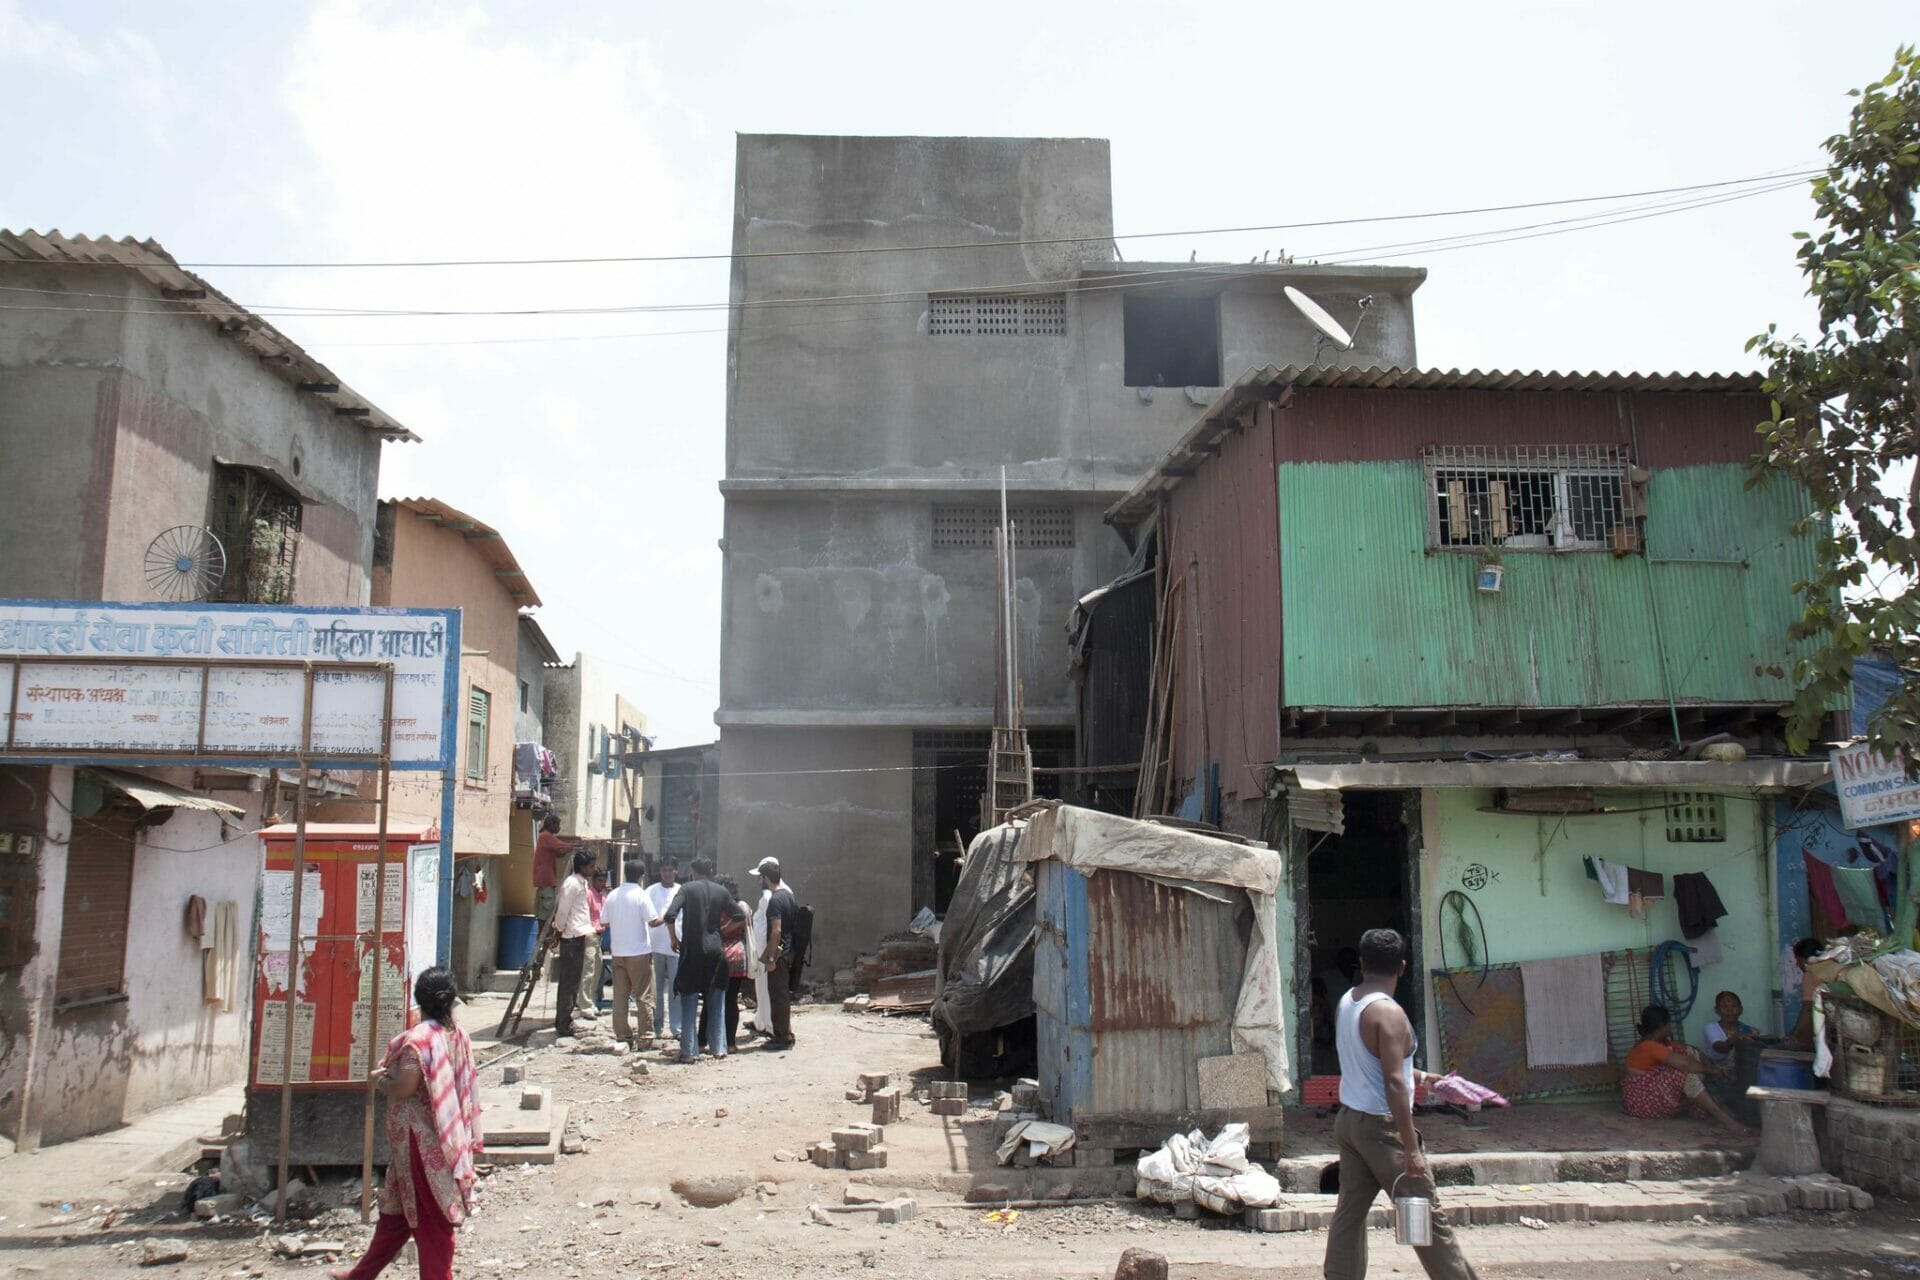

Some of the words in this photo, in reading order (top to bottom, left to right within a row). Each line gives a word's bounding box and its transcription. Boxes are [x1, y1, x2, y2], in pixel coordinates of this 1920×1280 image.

[90, 613, 151, 651] सेवा
[217, 616, 312, 656] समिती
[313, 619, 376, 661] महिला
[1844, 780, 1893, 798] COMMON
